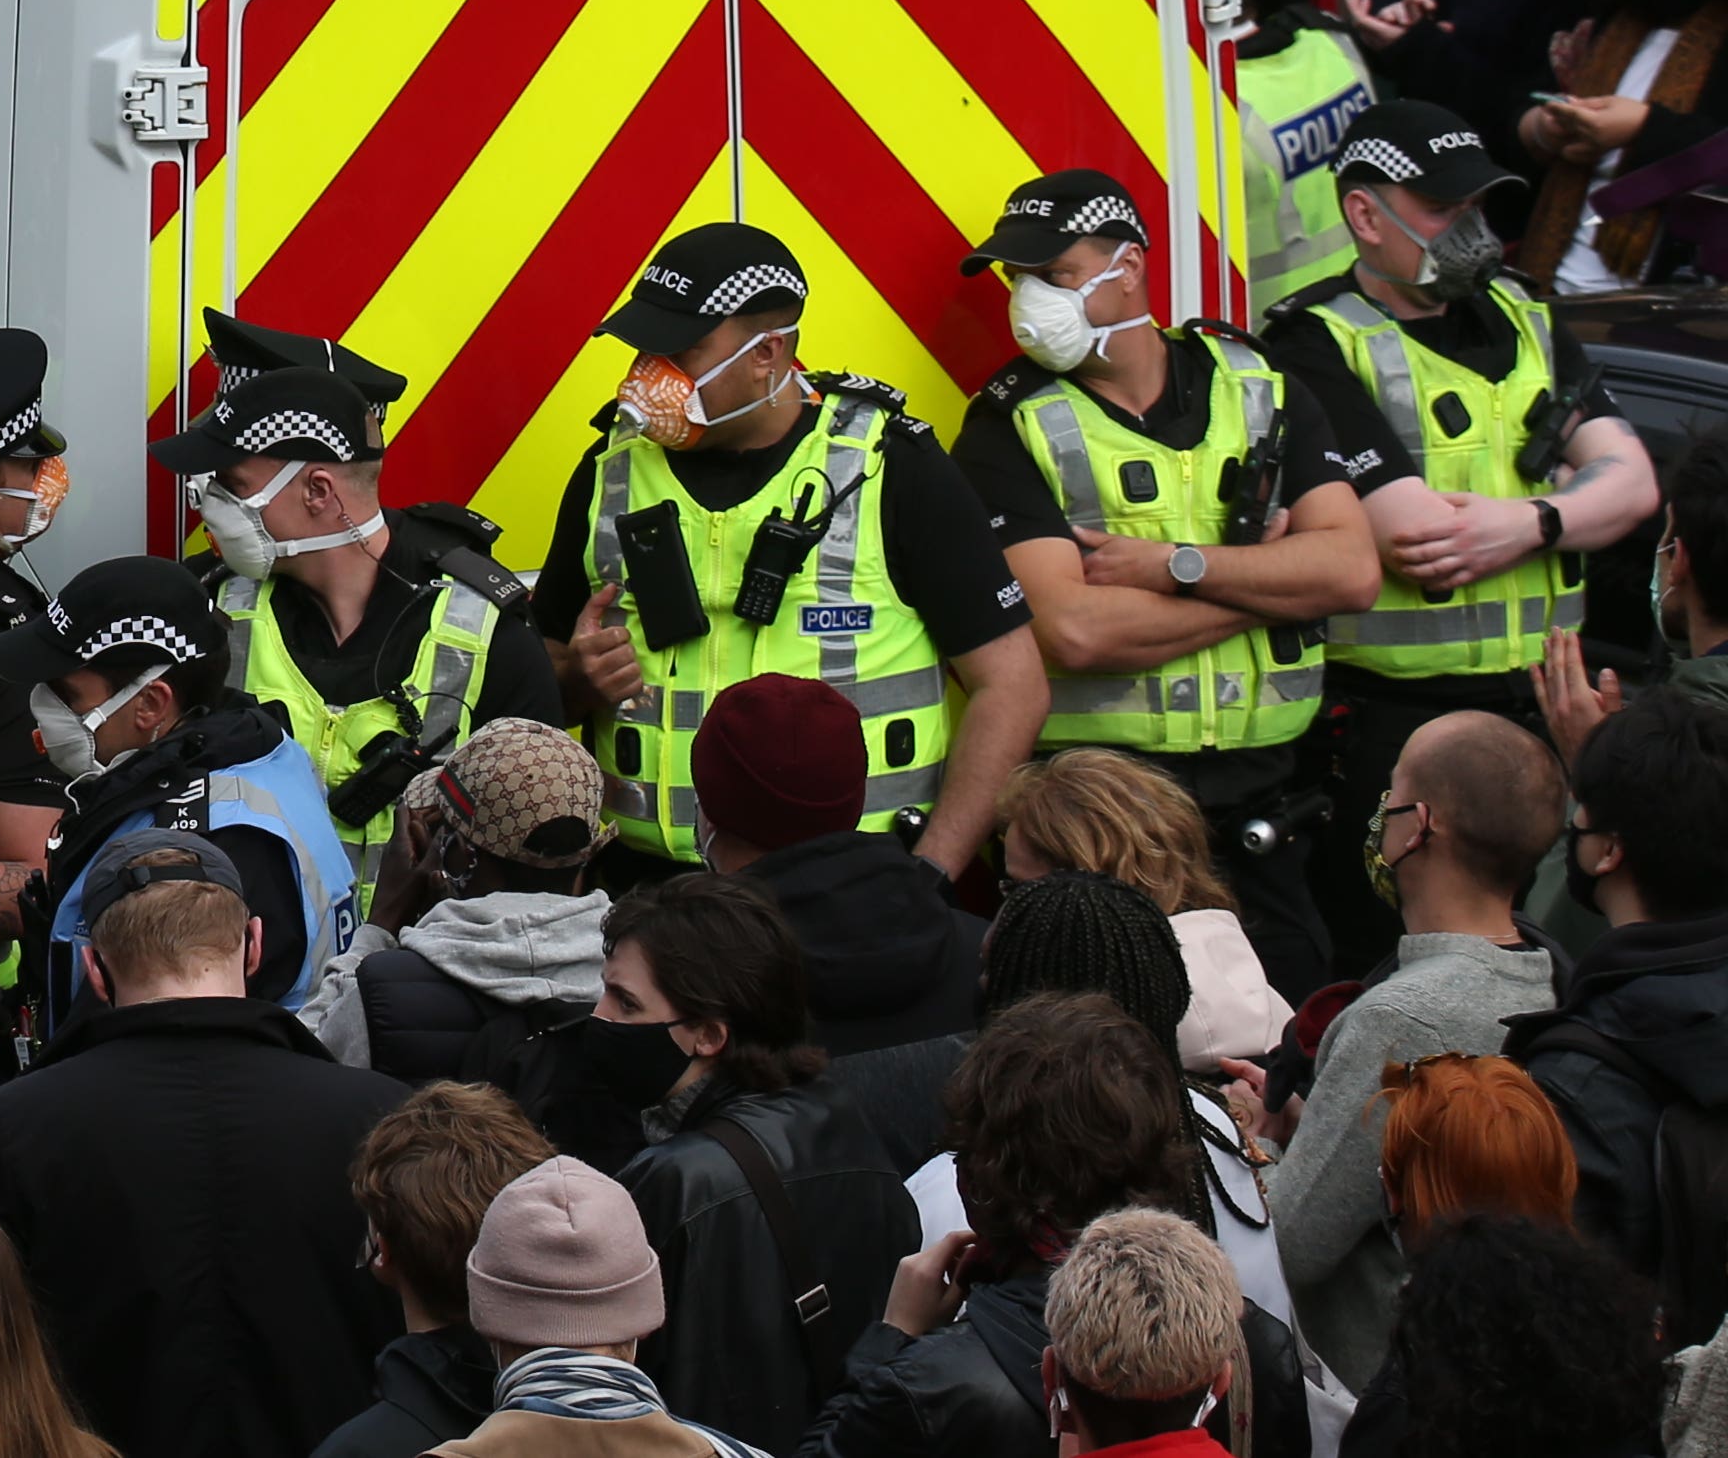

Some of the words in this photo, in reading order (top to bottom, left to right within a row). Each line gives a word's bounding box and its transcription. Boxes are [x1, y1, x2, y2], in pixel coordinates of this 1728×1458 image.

[1277, 88, 1368, 173] POLICE
[1428, 132, 1483, 154] POLICE
[1005, 199, 1054, 217] OLICE
[644, 265, 693, 295] OLICE
[488, 574, 500, 584] G
[807, 609, 868, 629] POLICE
[178, 807, 189, 817] K
[169, 819, 199, 830] 409
